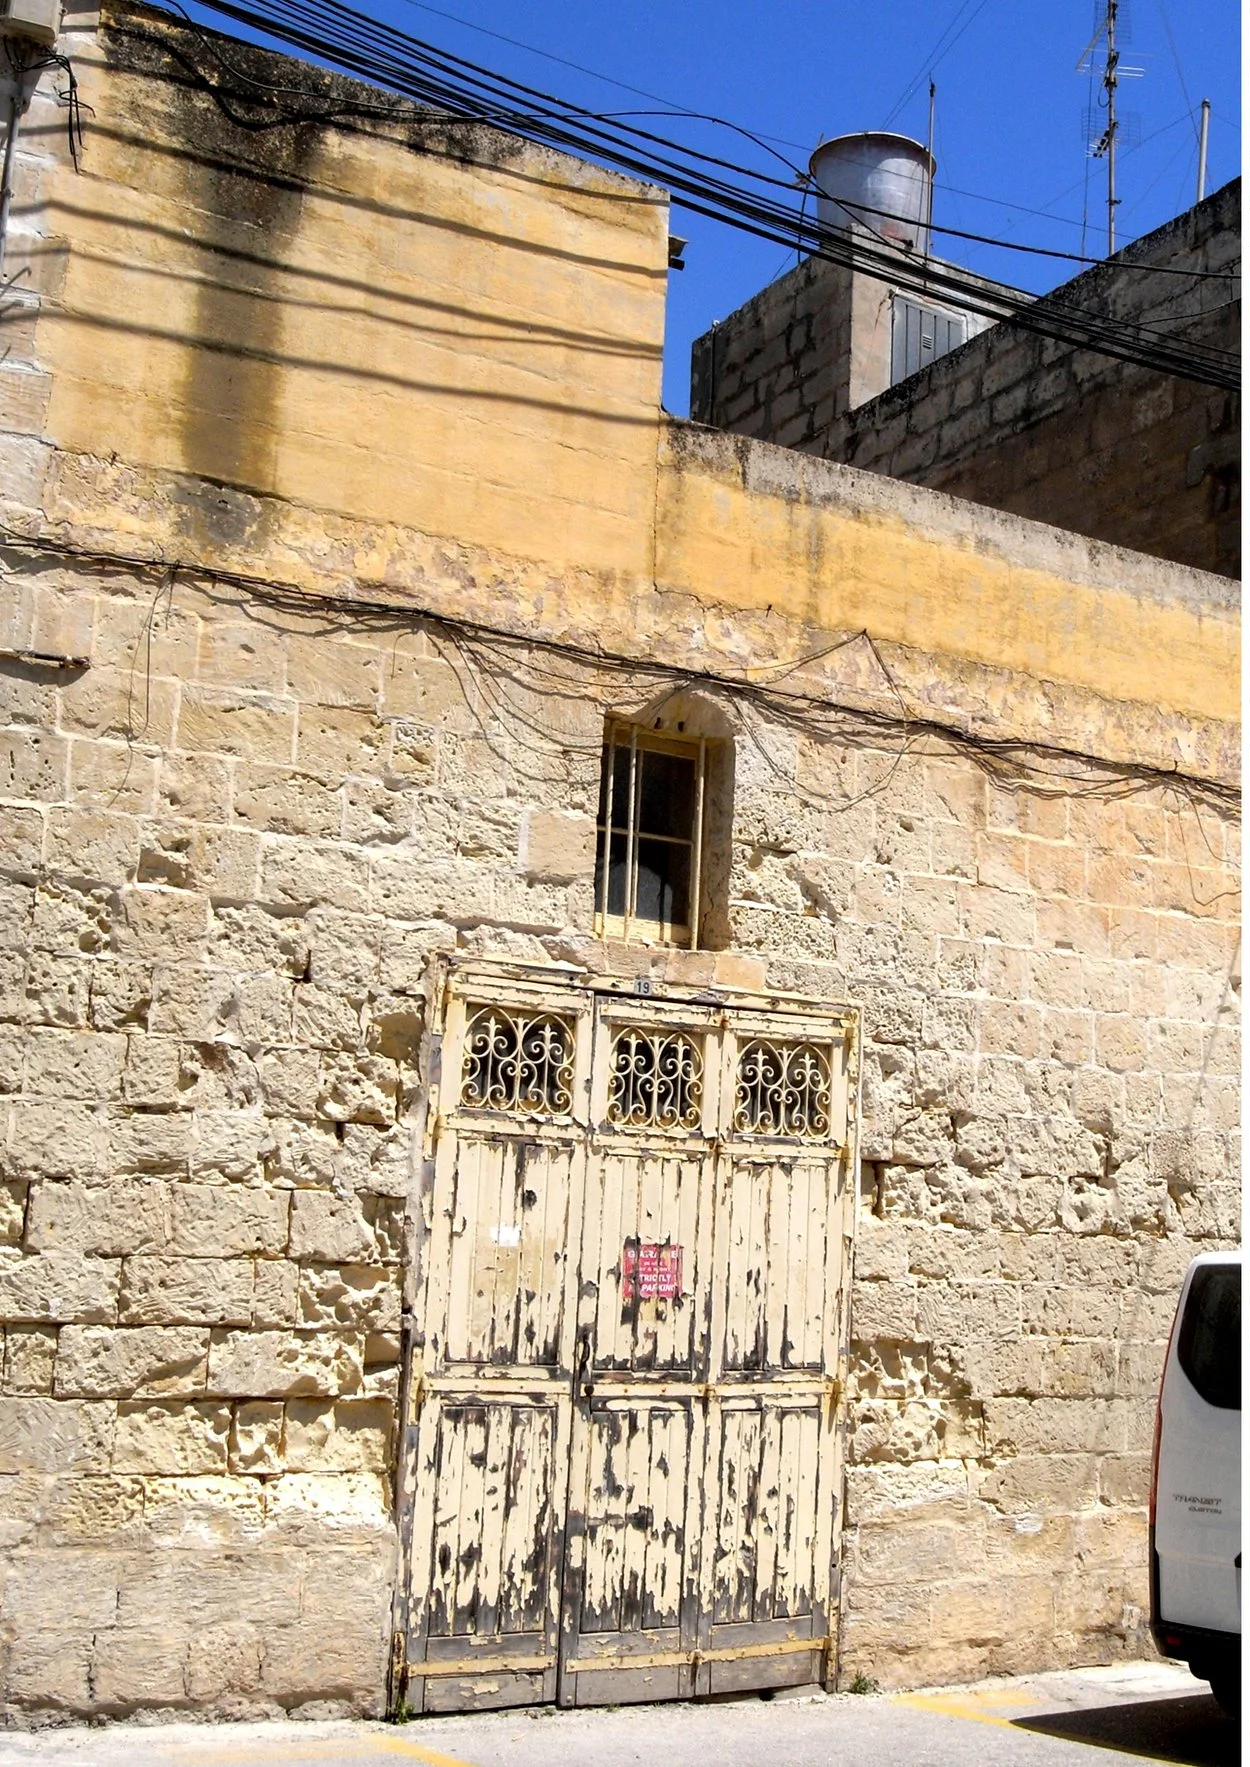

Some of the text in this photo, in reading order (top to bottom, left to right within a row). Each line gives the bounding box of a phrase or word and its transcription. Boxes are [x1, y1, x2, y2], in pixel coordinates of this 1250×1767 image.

[637, 981, 650, 994] 19
[628, 1250, 678, 1259] GARAE
[633, 1274, 672, 1283] TRICTLY
